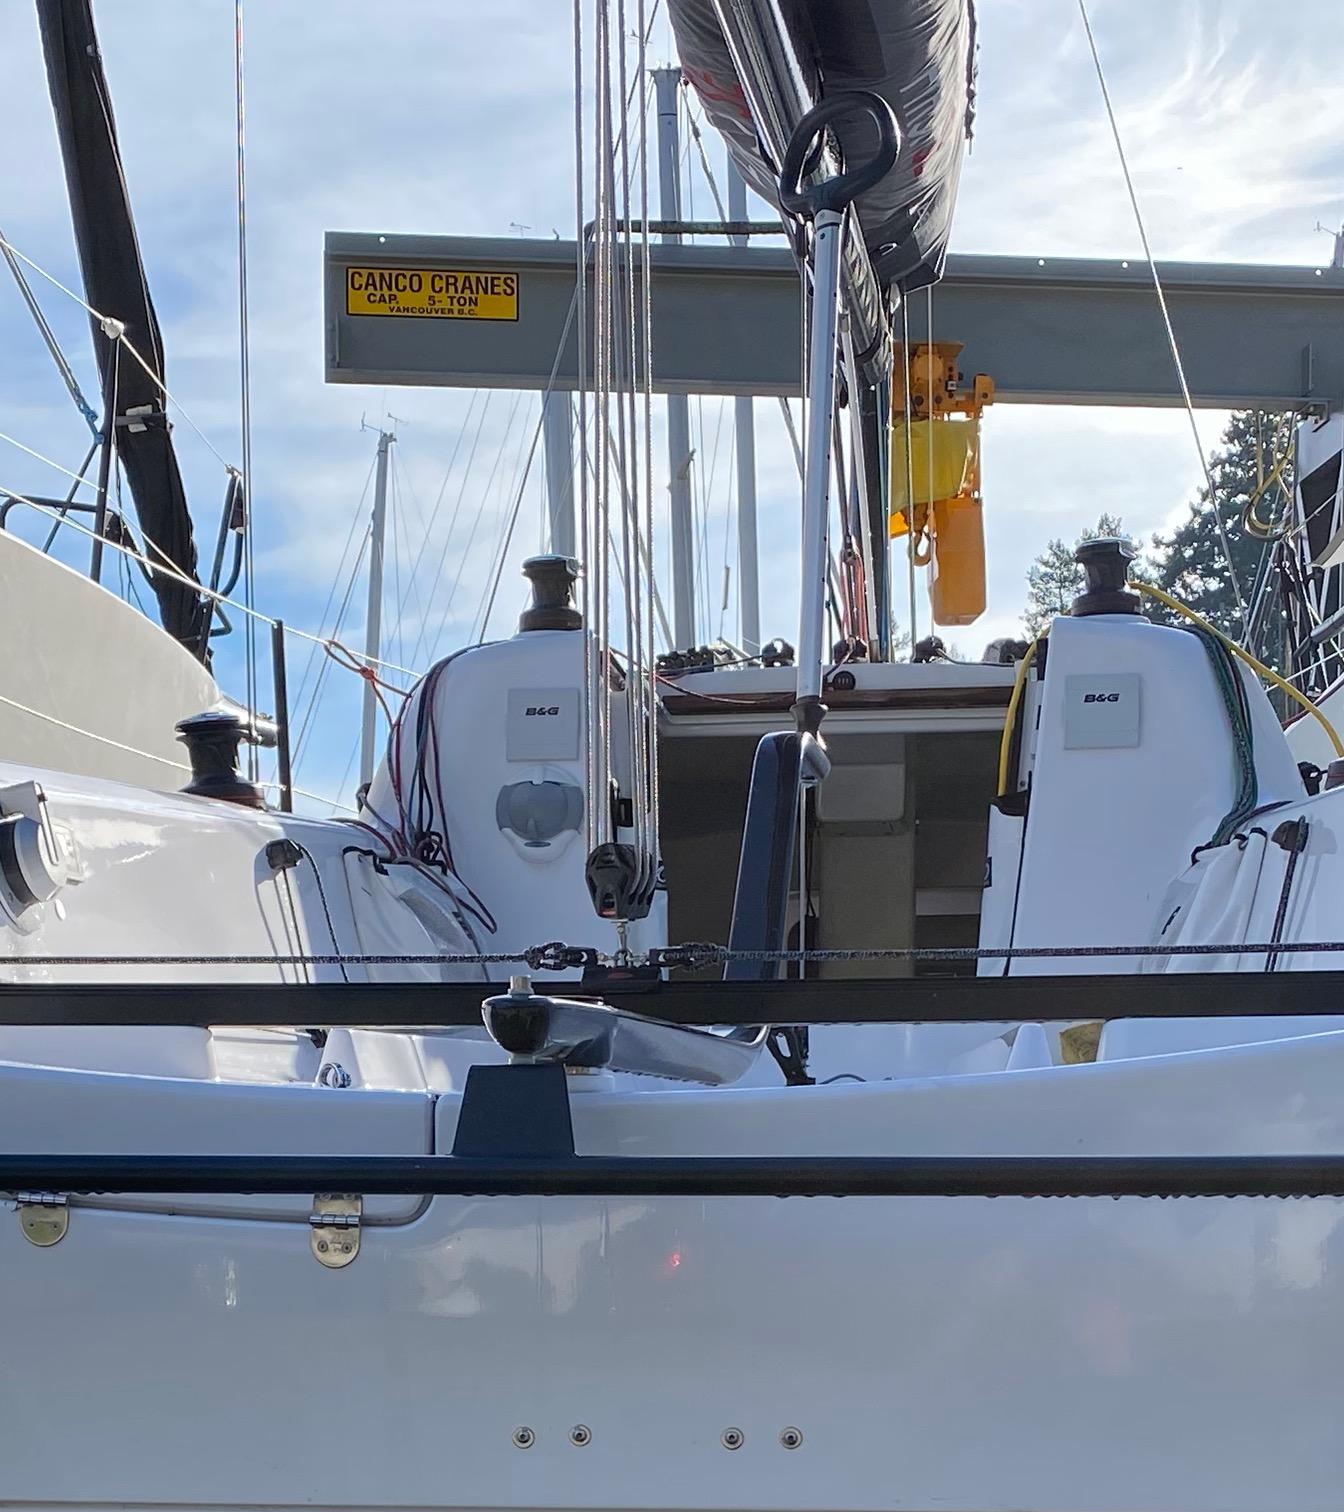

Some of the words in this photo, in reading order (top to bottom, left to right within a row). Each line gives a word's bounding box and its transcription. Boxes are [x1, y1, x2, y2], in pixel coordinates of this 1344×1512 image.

[350, 271, 423, 294] CANCO
[431, 274, 515, 297] CRANES
[367, 292, 399, 305] CAP.
[447, 295, 479, 308] TON
[388, 306, 454, 316] VANCOUVER
[457, 308, 478, 317] B.C.
[1083, 692, 1121, 703] B&G
[525, 706, 560, 716] B&G
